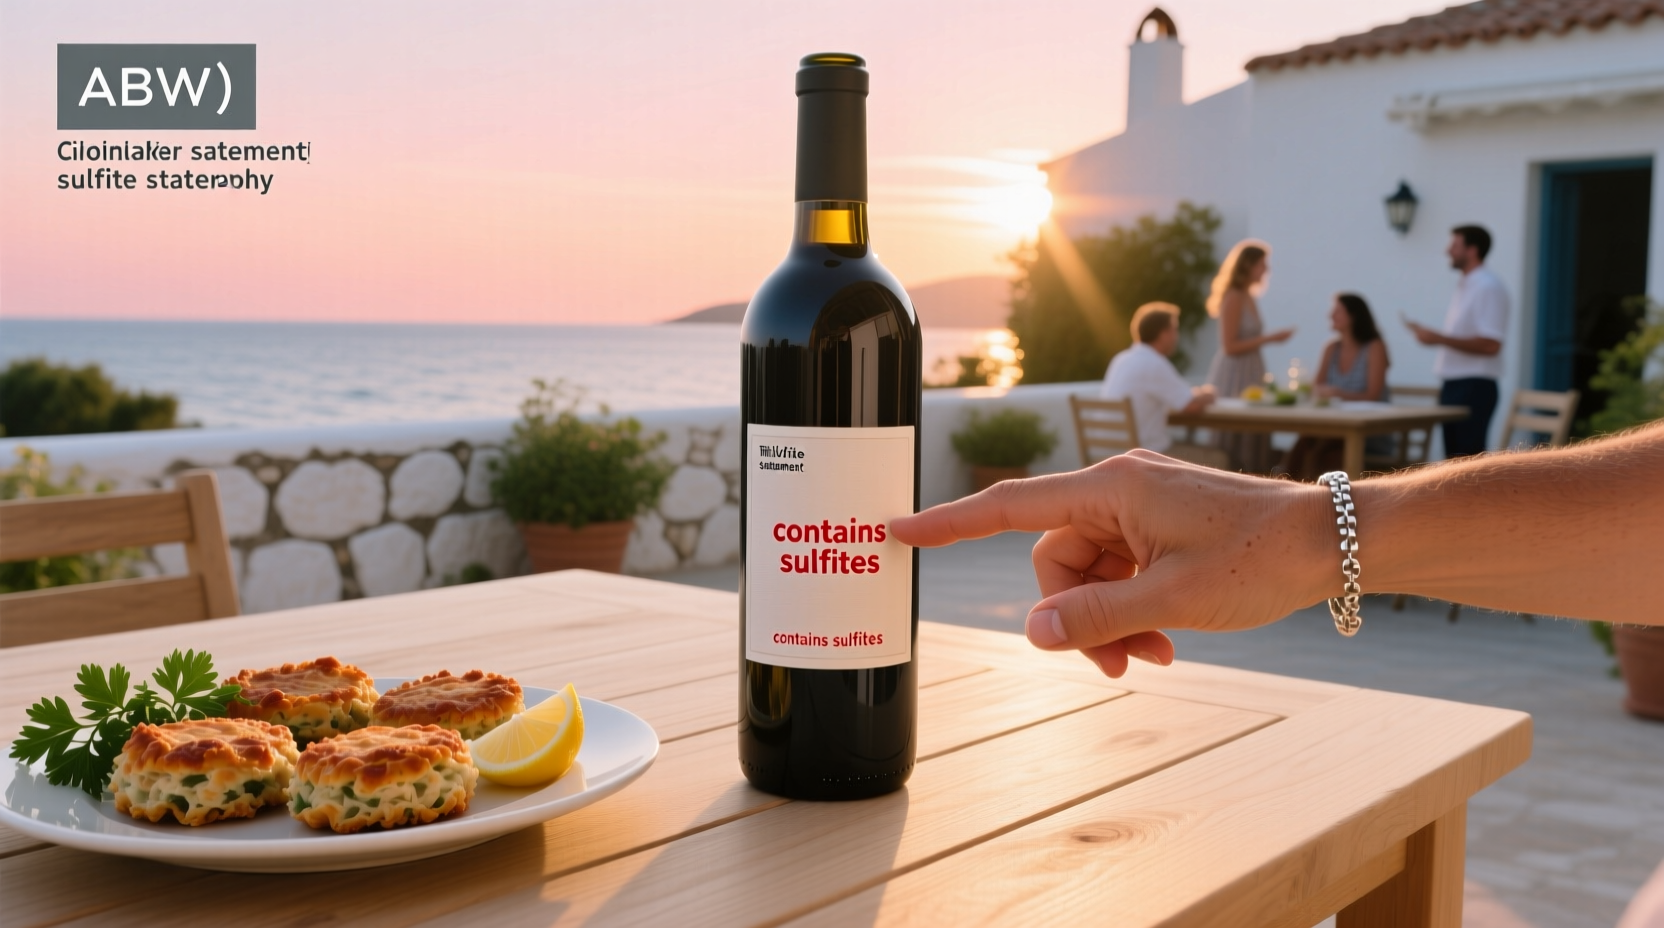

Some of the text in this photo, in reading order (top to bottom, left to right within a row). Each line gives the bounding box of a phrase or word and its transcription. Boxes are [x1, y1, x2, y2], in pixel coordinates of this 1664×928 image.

[773, 517, 887, 544] contains
[780, 548, 880, 575] sulfites
[773, 631, 883, 647] contains sulfites
